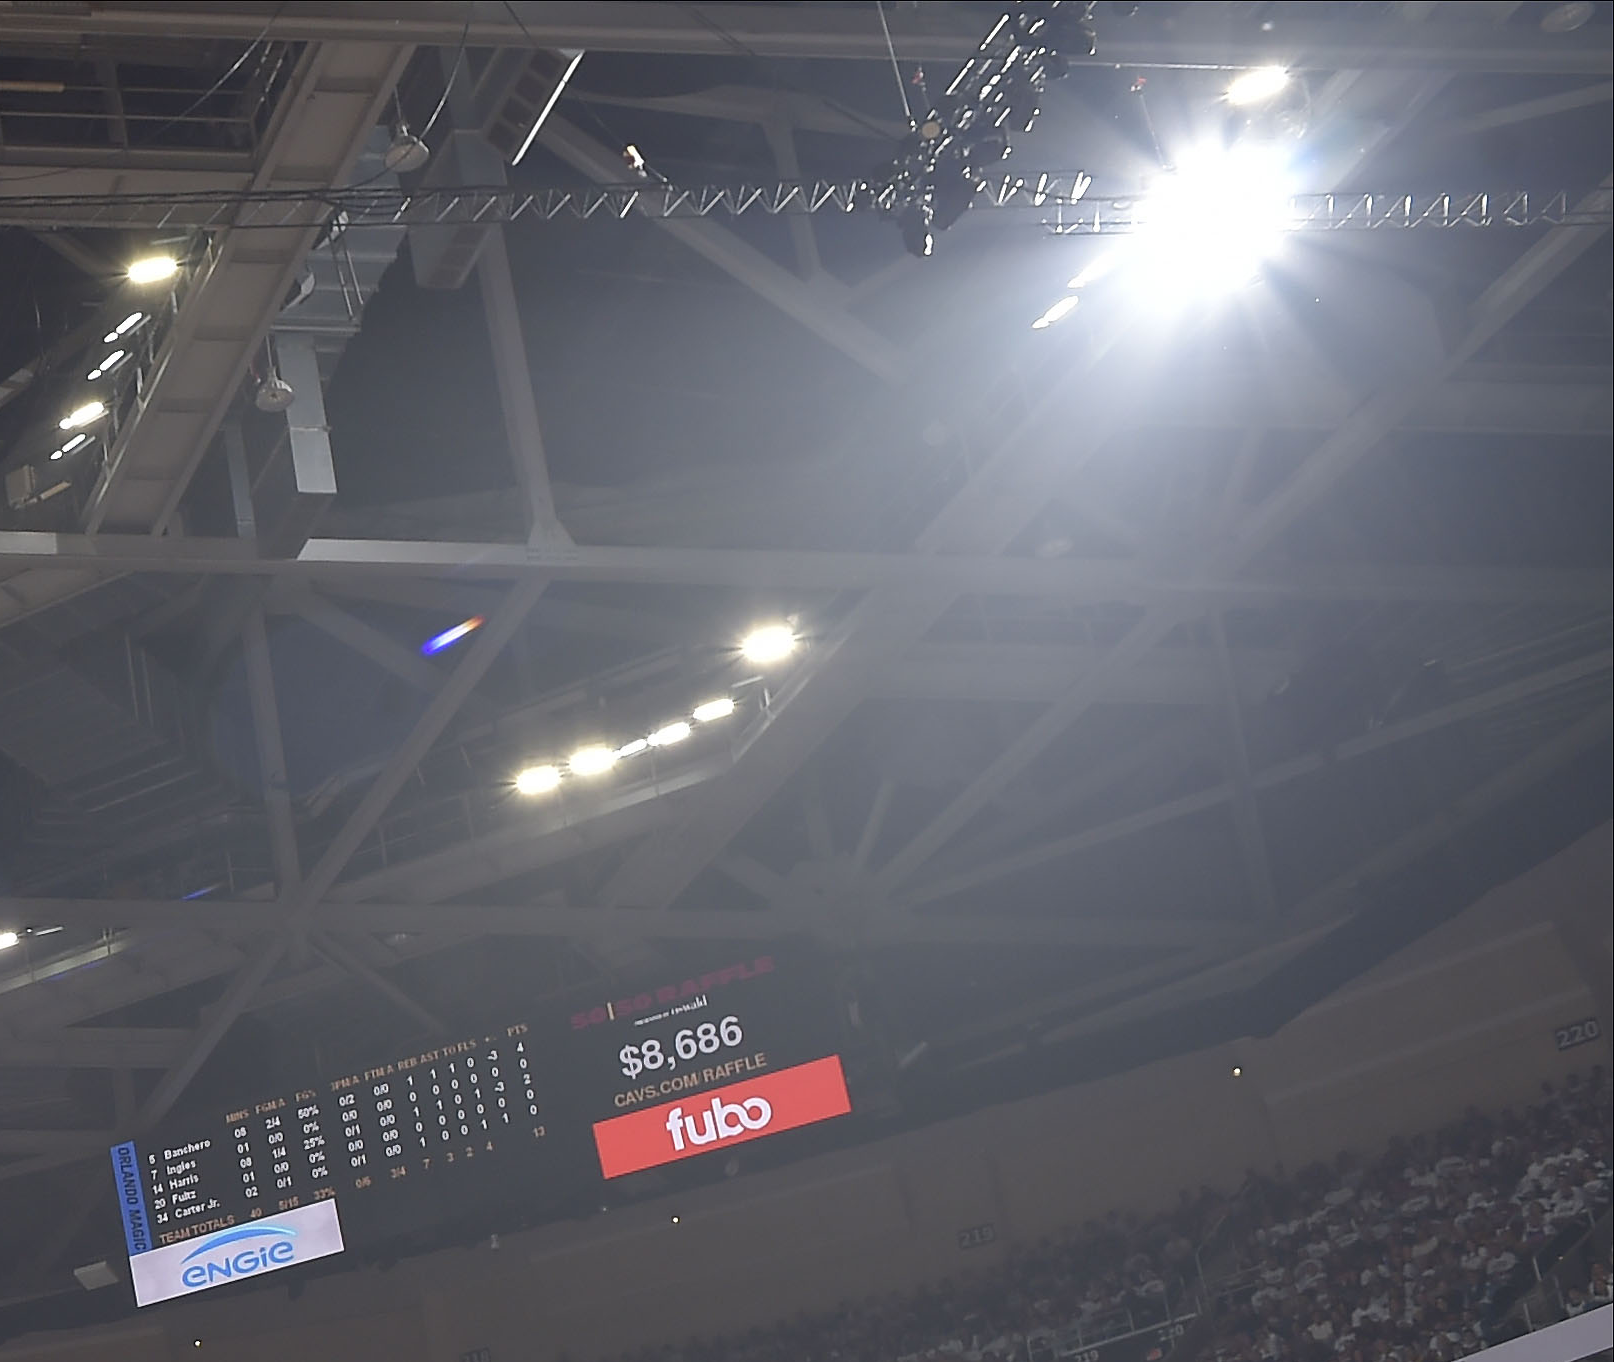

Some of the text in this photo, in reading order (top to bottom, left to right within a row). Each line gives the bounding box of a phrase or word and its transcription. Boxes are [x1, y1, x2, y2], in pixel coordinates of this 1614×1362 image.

[619, 1016, 742, 1079] $8,686
[1558, 1019, 1601, 1047] 220
[666, 1097, 772, 1151] fubo
[164, 1139, 211, 1159] Banchero
[152, 1174, 199, 1195] 14 Harris
[166, 1160, 196, 1176] Ingles
[117, 1147, 147, 1250] ORLANDO MAGIC
[154, 1199, 166, 1209] 20
[243, 1172, 255, 1182] 01
[157, 1214, 168, 1224] 34
[175, 1203, 205, 1218] Carter
[246, 1187, 258, 1198] 02
[159, 1215, 234, 1244] TEAM TOTALS
